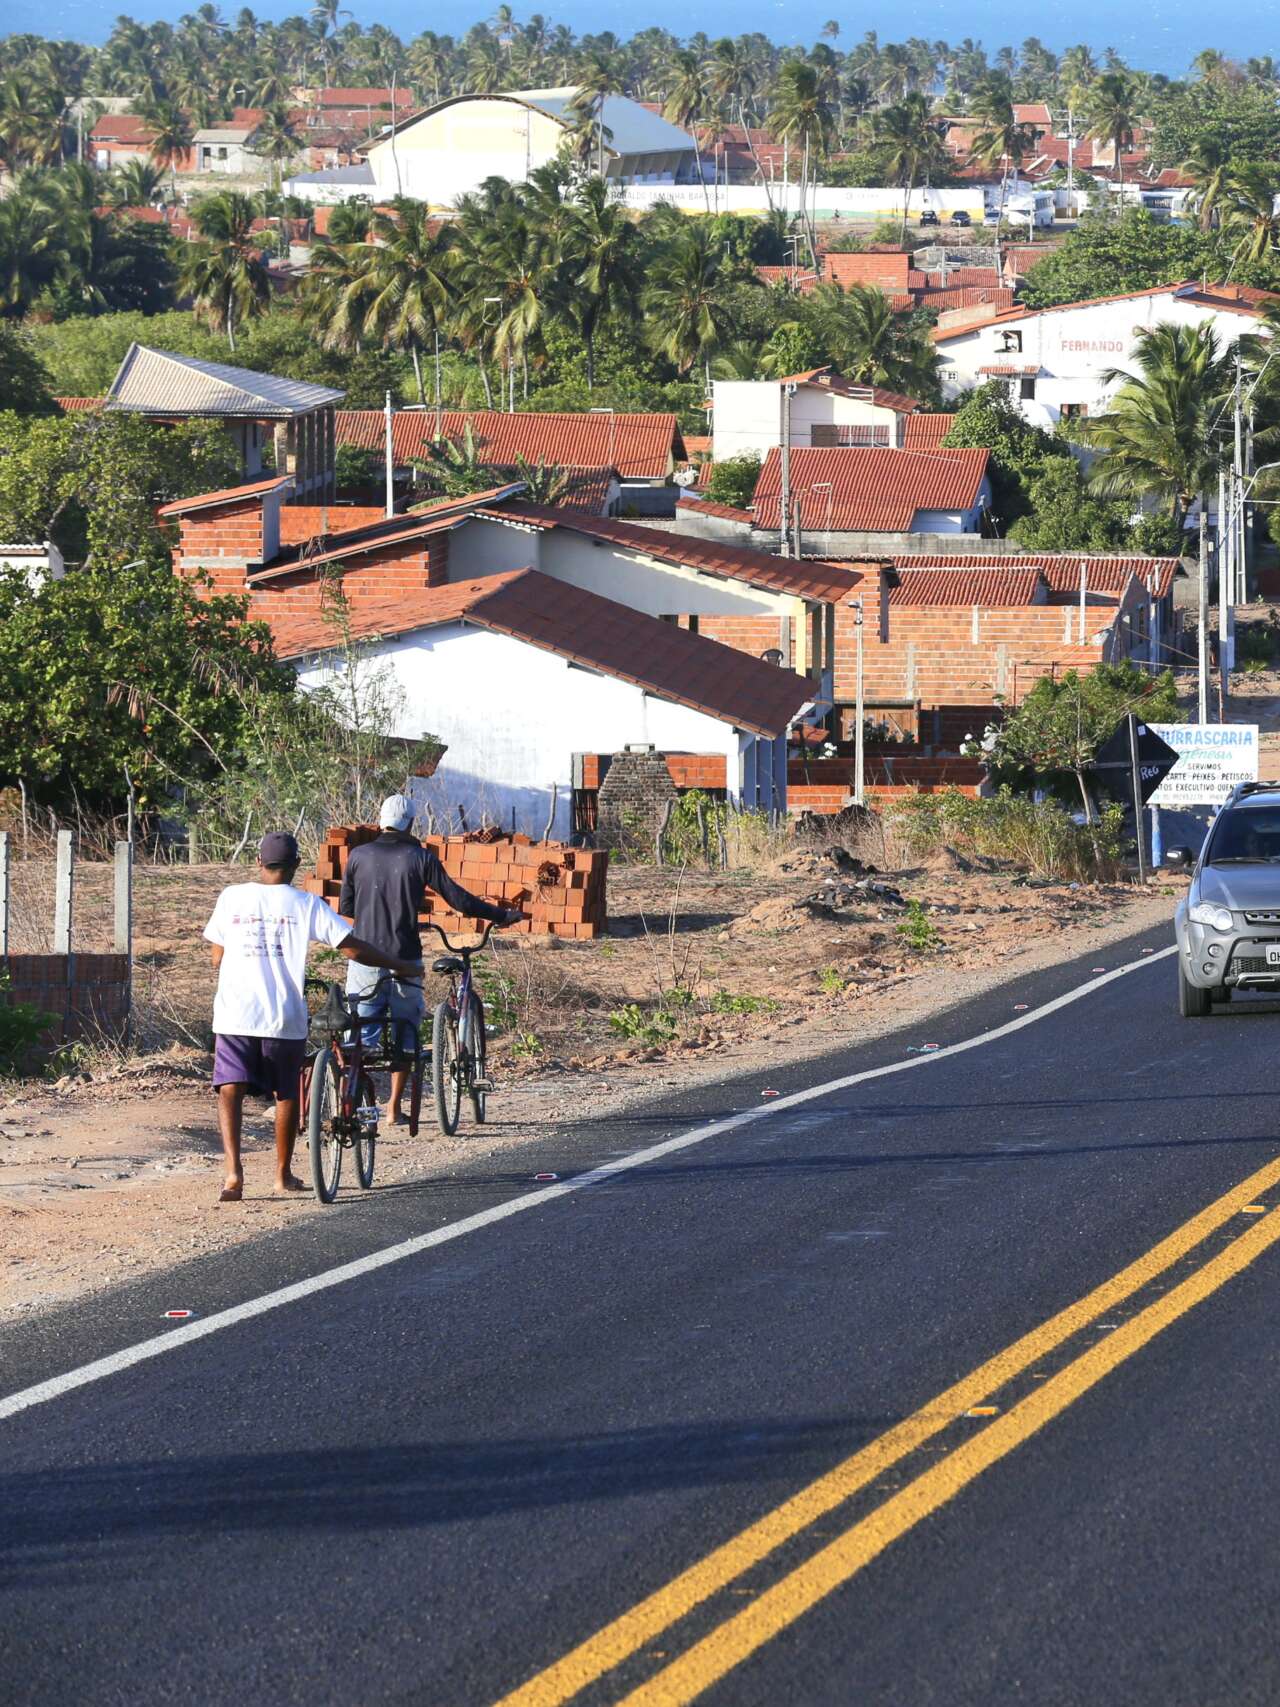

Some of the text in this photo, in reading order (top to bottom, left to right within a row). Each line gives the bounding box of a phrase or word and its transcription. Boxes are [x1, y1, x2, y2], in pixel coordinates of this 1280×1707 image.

[1061, 340, 1123, 352] FERNANDO
[1187, 762, 1222, 771] SERVIMOS
[1192, 772, 1216, 781] PEIXES
[1221, 772, 1254, 781] PETISCOS
